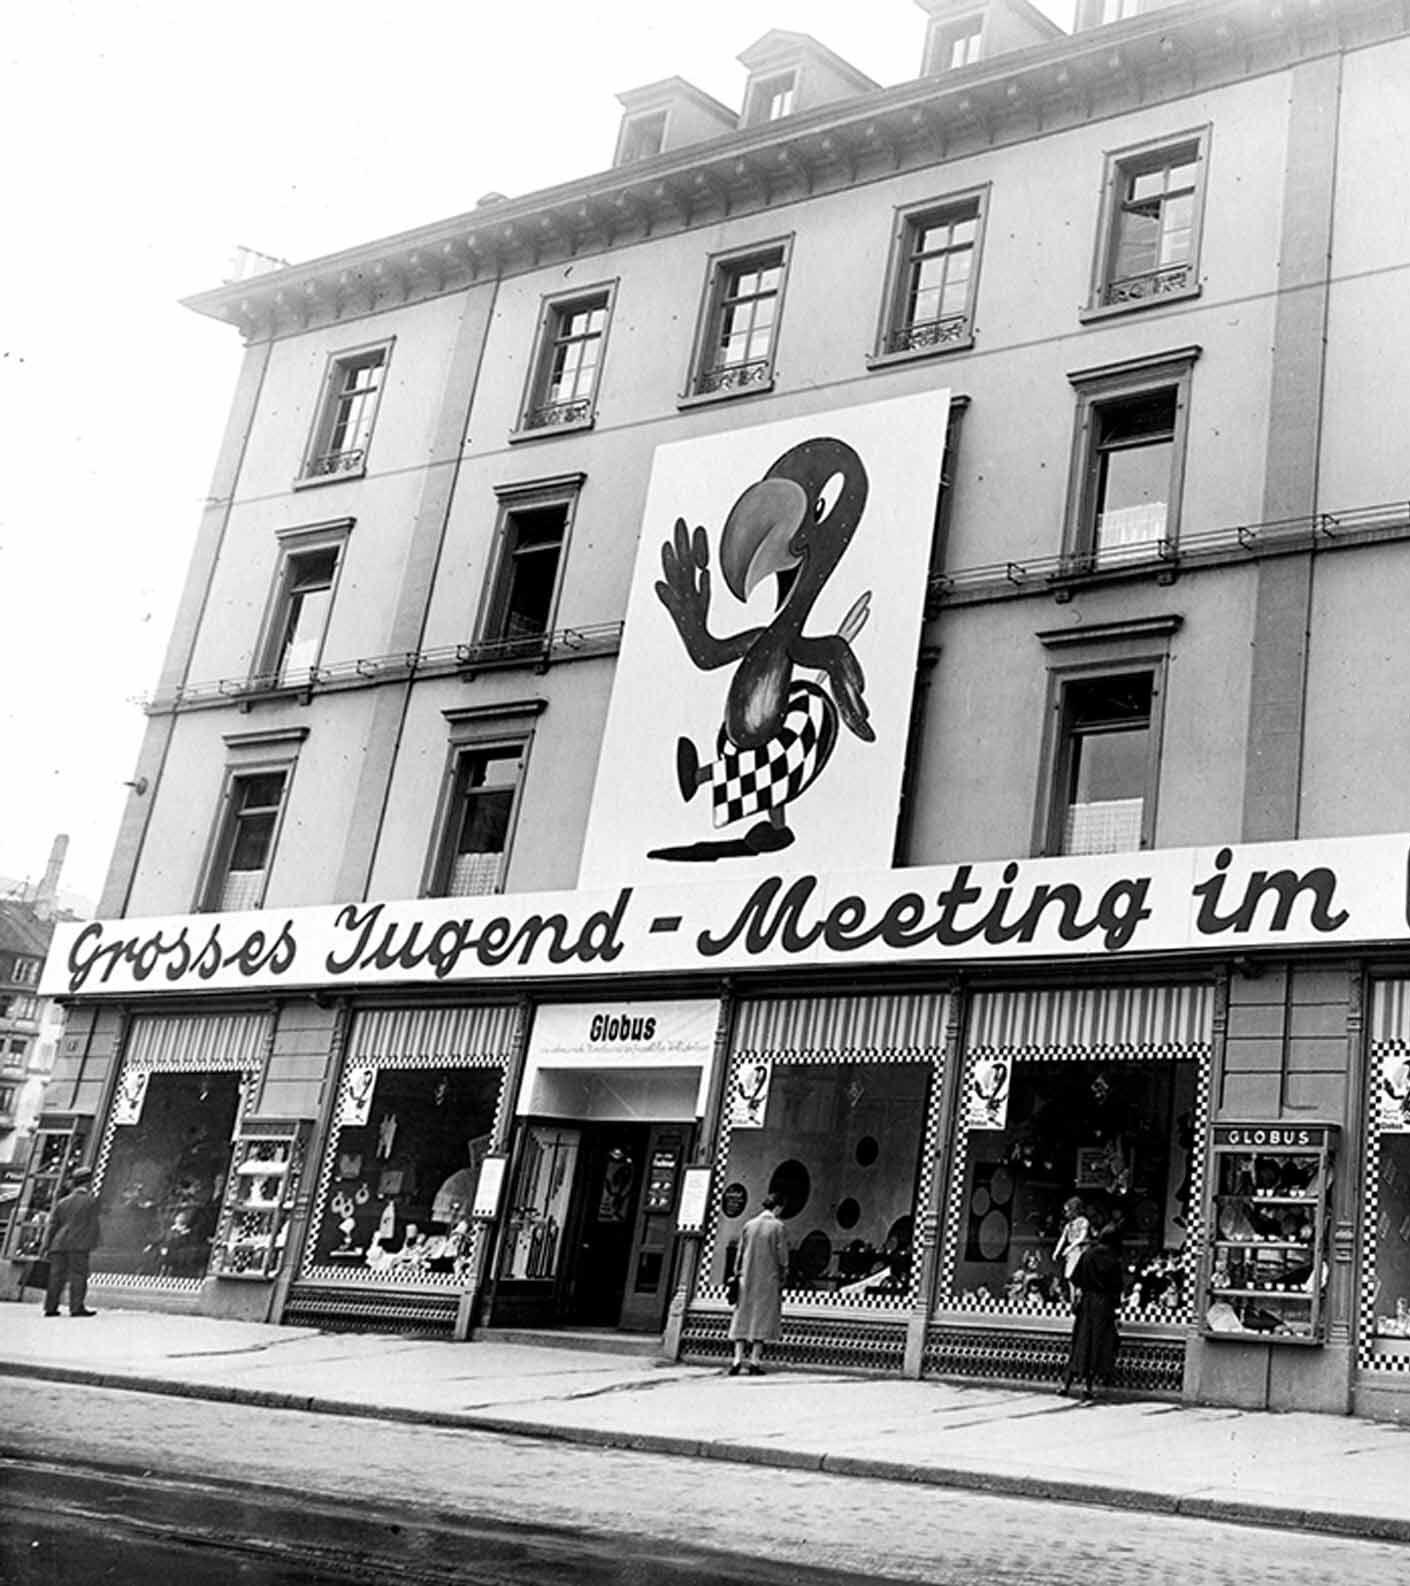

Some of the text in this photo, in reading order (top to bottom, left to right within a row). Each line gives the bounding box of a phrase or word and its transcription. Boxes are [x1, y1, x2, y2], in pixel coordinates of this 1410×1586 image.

[67, 922, 298, 993] Grosses
[325, 887, 634, 980] Jugend
[696, 861, 1153, 957] Meeting
[1192, 846, 1350, 936] im
[589, 1013, 657, 1043] Globus
[1228, 1130, 1309, 1145] GLOBUS
